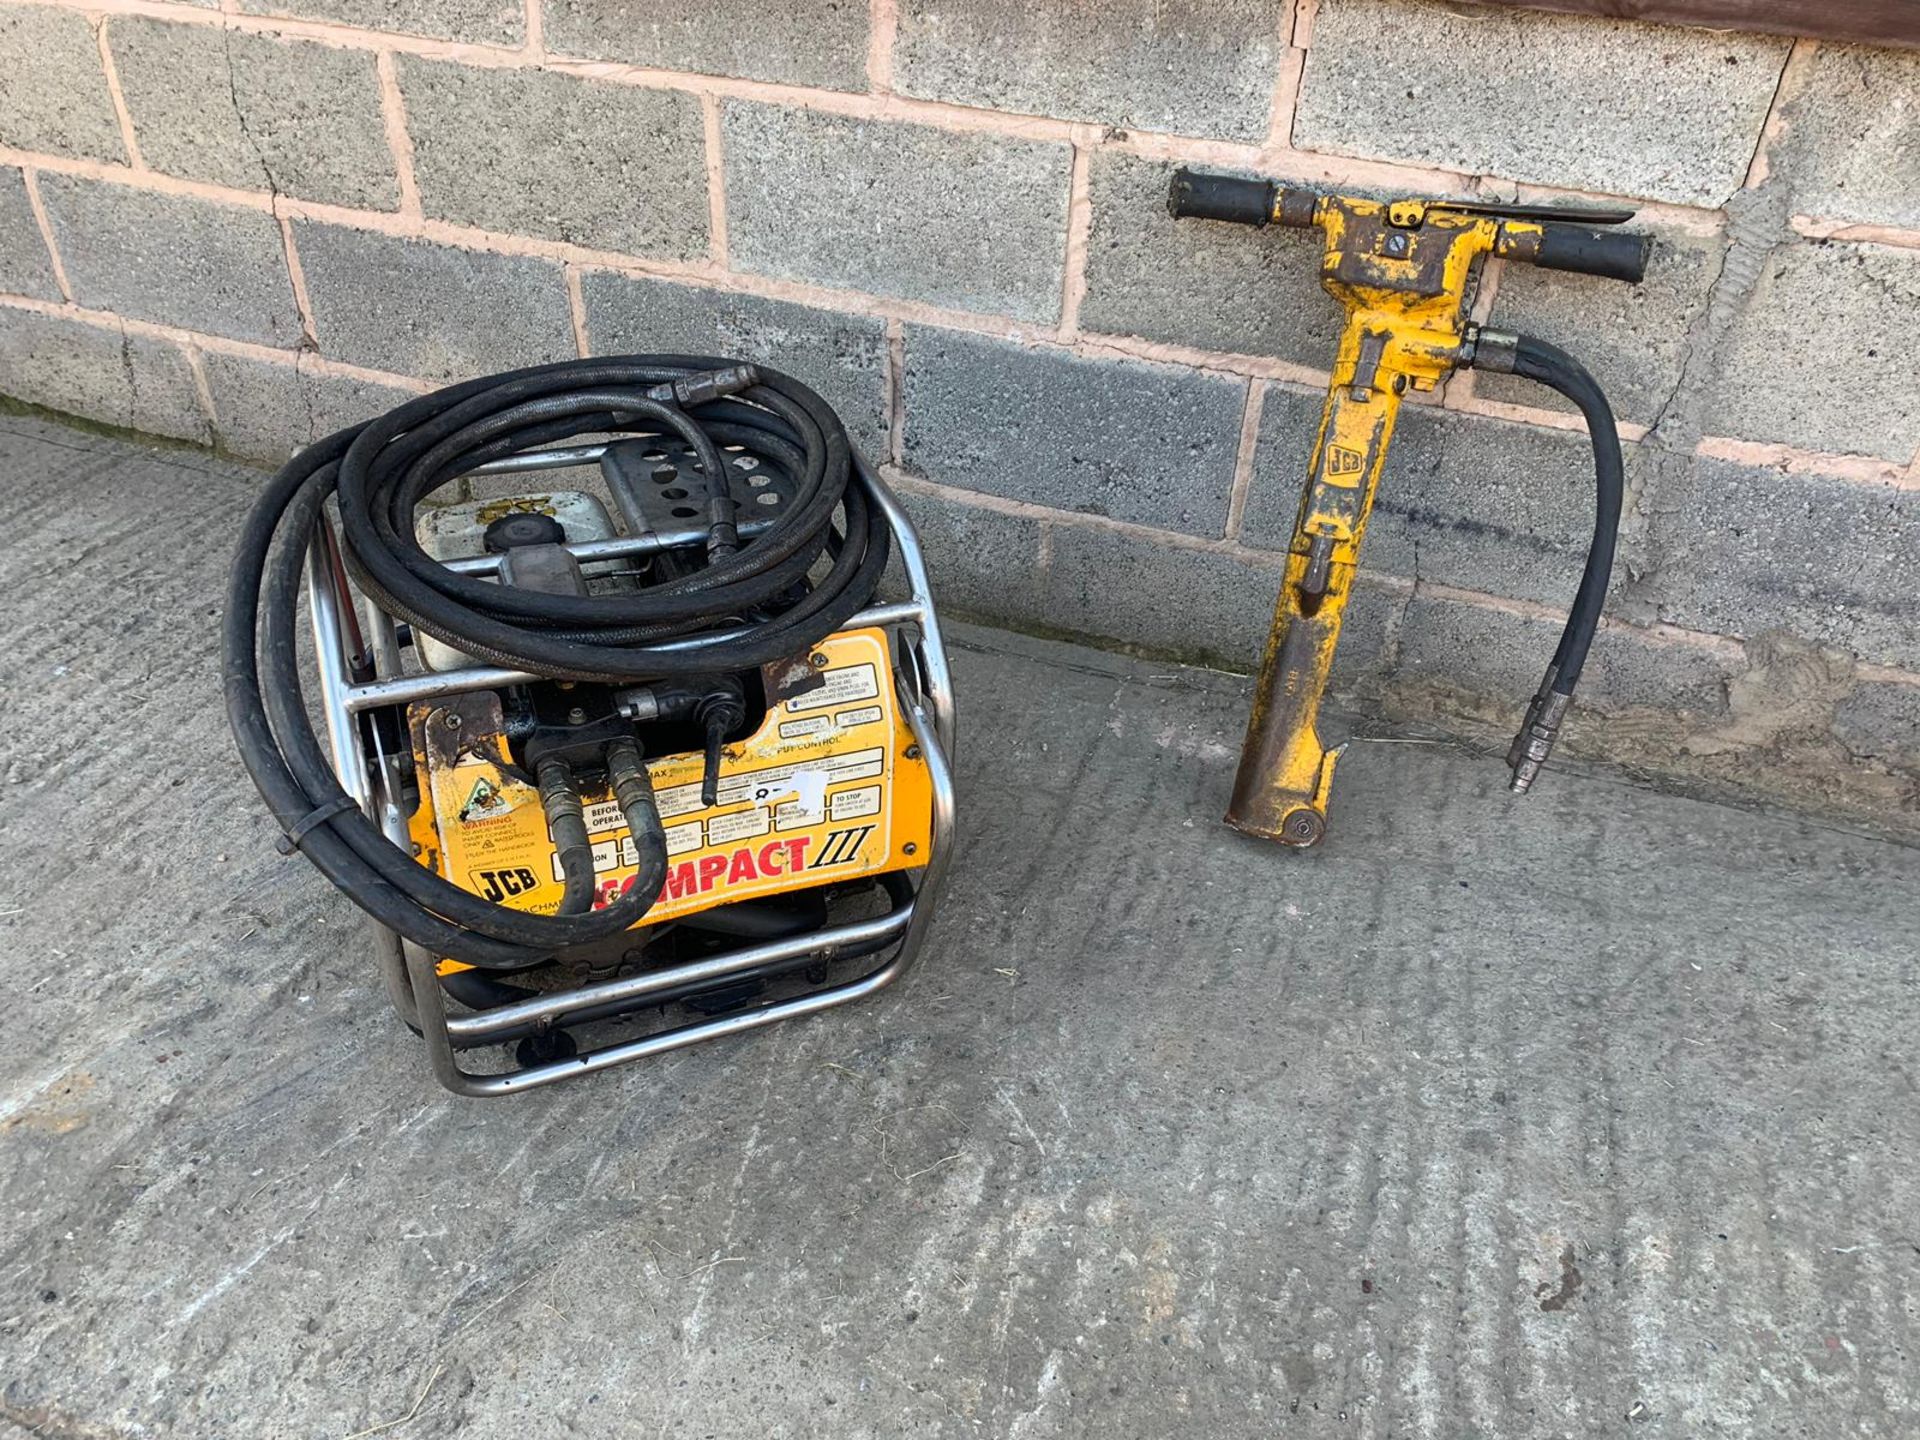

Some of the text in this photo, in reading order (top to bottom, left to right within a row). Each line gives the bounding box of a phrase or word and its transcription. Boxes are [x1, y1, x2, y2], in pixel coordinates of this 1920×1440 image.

[1331, 448, 1360, 472] JCB
[592, 805, 619, 817] BEFOR
[462, 815, 513, 830] WARNING
[592, 814, 624, 827] OPERAT
[480, 869, 536, 902] JCB
